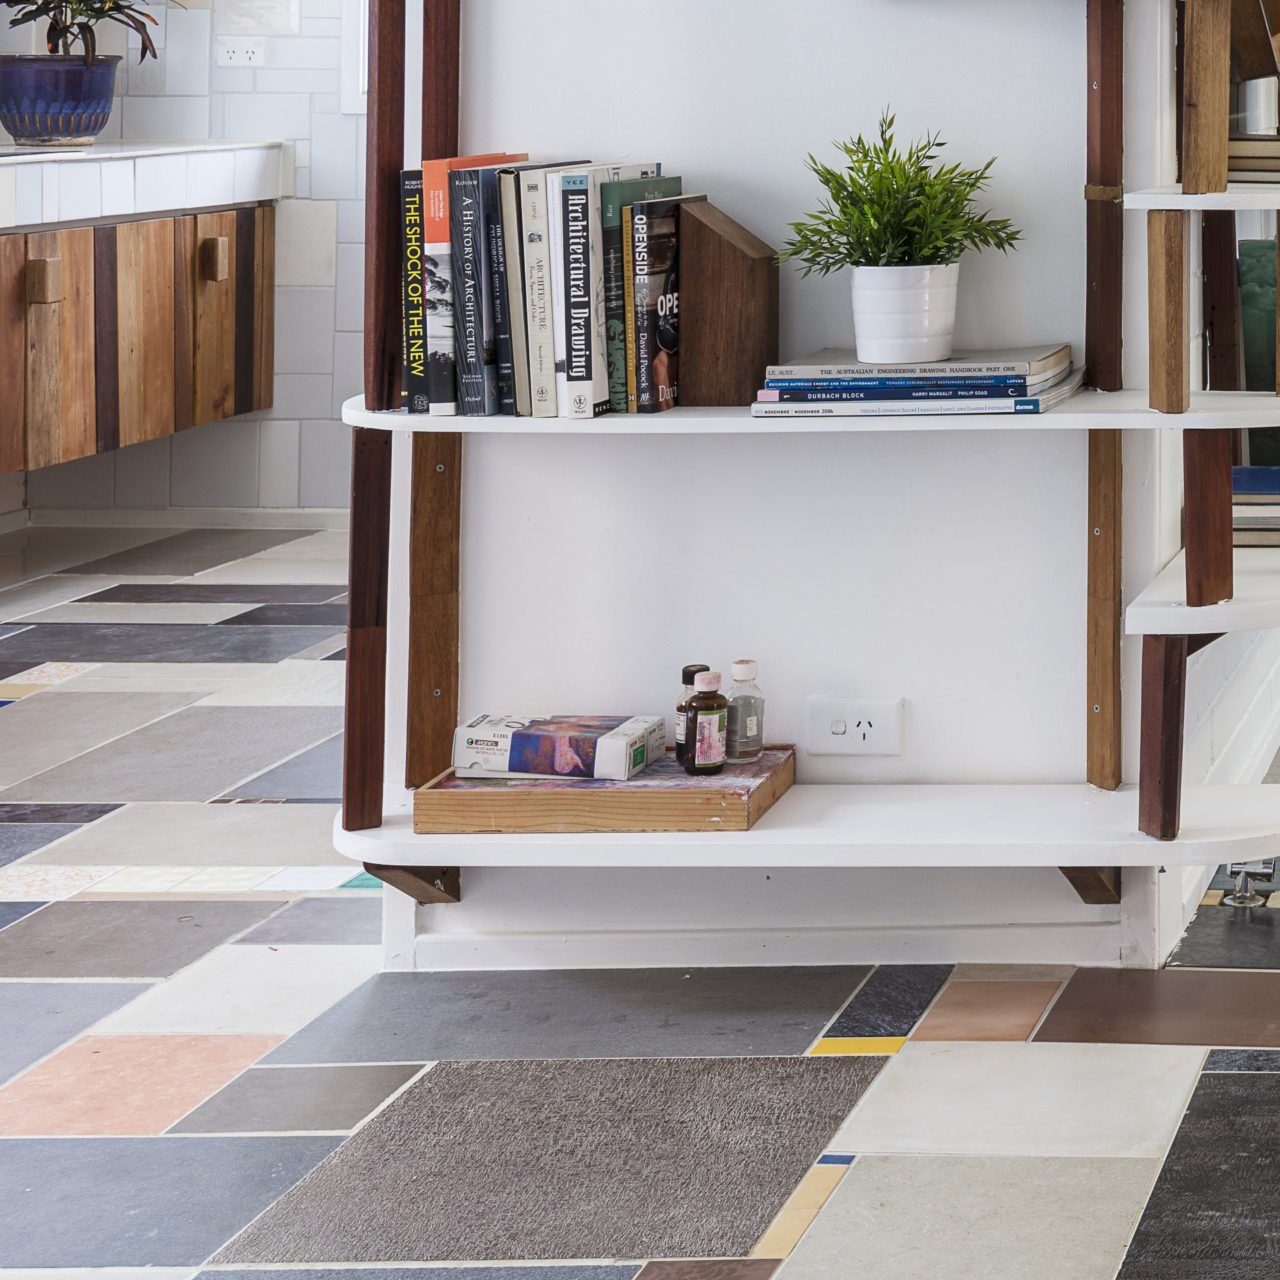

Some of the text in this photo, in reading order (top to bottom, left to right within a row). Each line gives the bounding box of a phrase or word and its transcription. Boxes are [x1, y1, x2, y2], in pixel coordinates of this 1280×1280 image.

[462, 196, 473, 206] A
[462, 210, 474, 259] HISTORY
[634, 214, 648, 284] OPENSIDE
[405, 193, 425, 377] THE SHOCK OF THE NEW
[535, 257, 547, 330] ARCHITECTURE
[568, 194, 590, 378] Architectural Drawing
[464, 278, 477, 364] ARCHITECTURE
[639, 332, 648, 389] David Pocock
